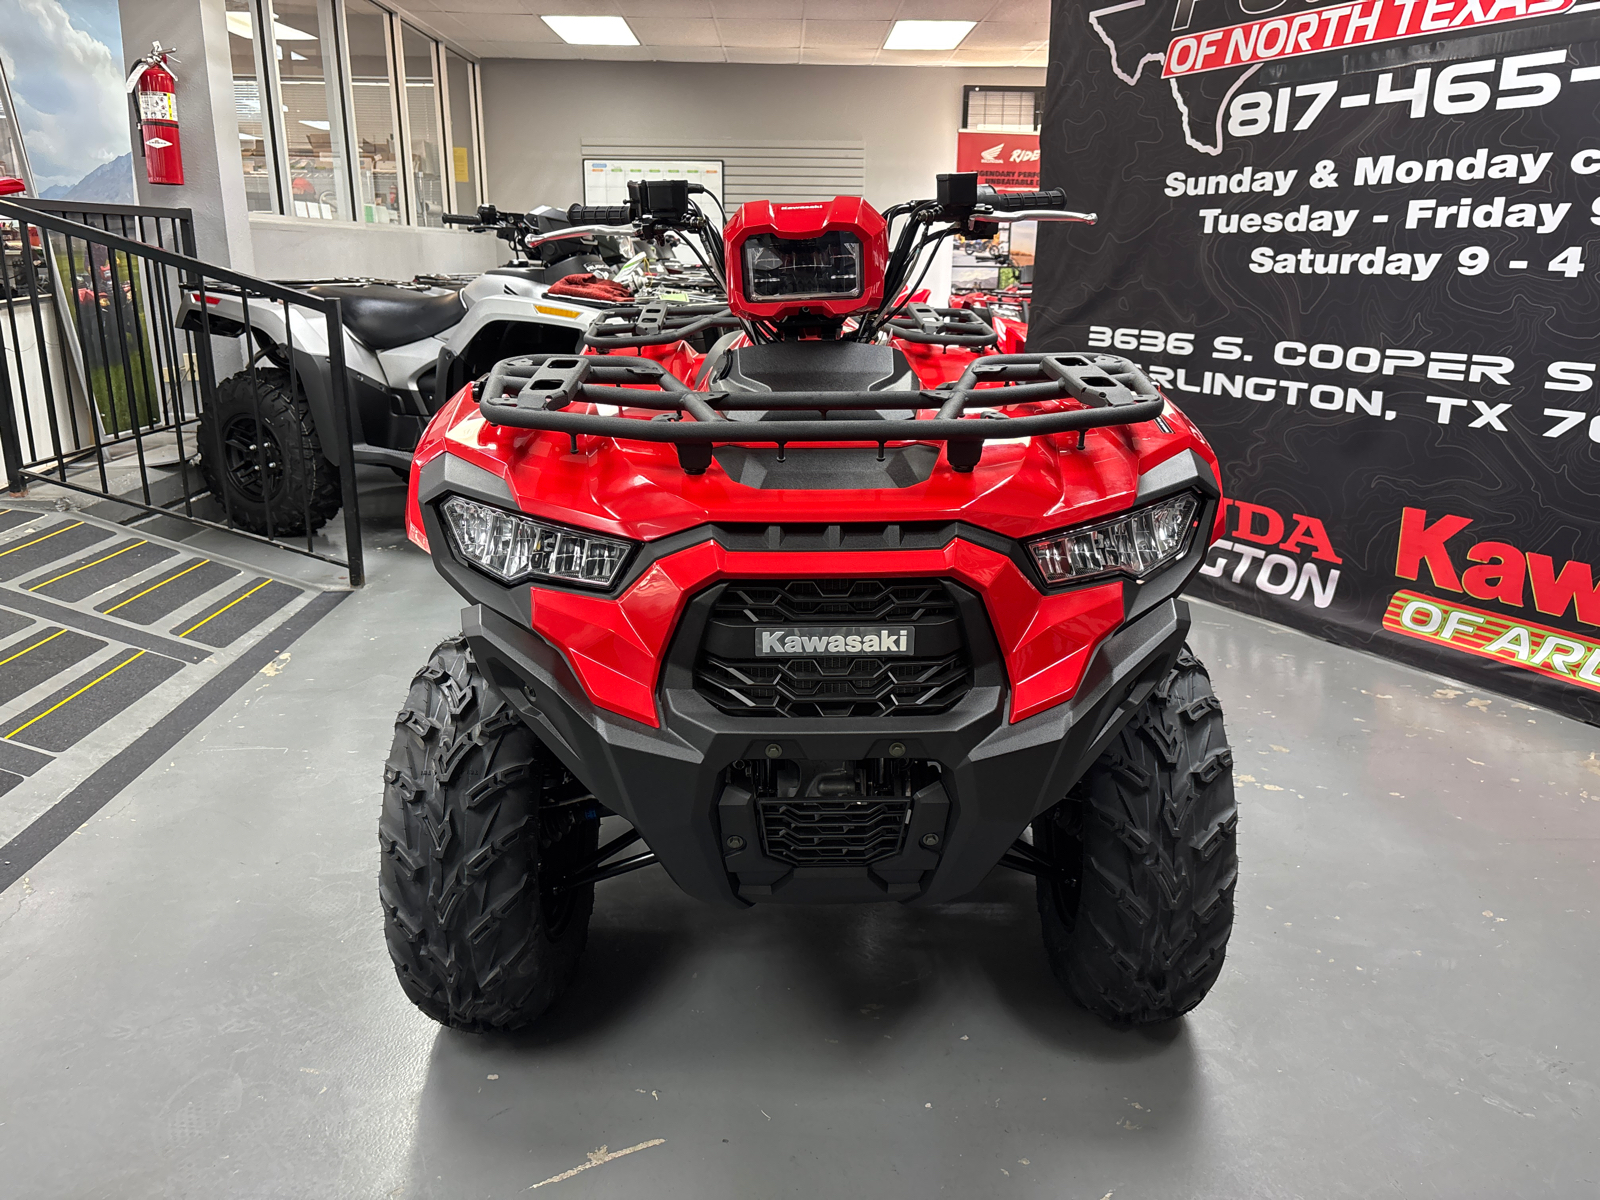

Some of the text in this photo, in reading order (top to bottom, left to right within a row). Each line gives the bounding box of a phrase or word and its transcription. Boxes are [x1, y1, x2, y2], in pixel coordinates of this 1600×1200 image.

[1170, 32, 1223, 73] OF
[1224, 0, 1383, 65] NORTH
[1164, 166, 1298, 197] Sunday
[1309, 159, 1339, 189] &
[1353, 148, 1553, 186] Monday
[1199, 205, 1360, 237] Tuesday
[1372, 214, 1389, 223] -
[1405, 196, 1572, 234] Friday
[1249, 246, 1585, 281] Saturday 9 - 4
[1088, 325, 1596, 392] 3636 S. COOPER S
[1134, 363, 1397, 421] RLINGTON,
[1425, 395, 1513, 432] TX
[762, 630, 907, 653] Kawasaki
[1401, 600, 1485, 639] OF
